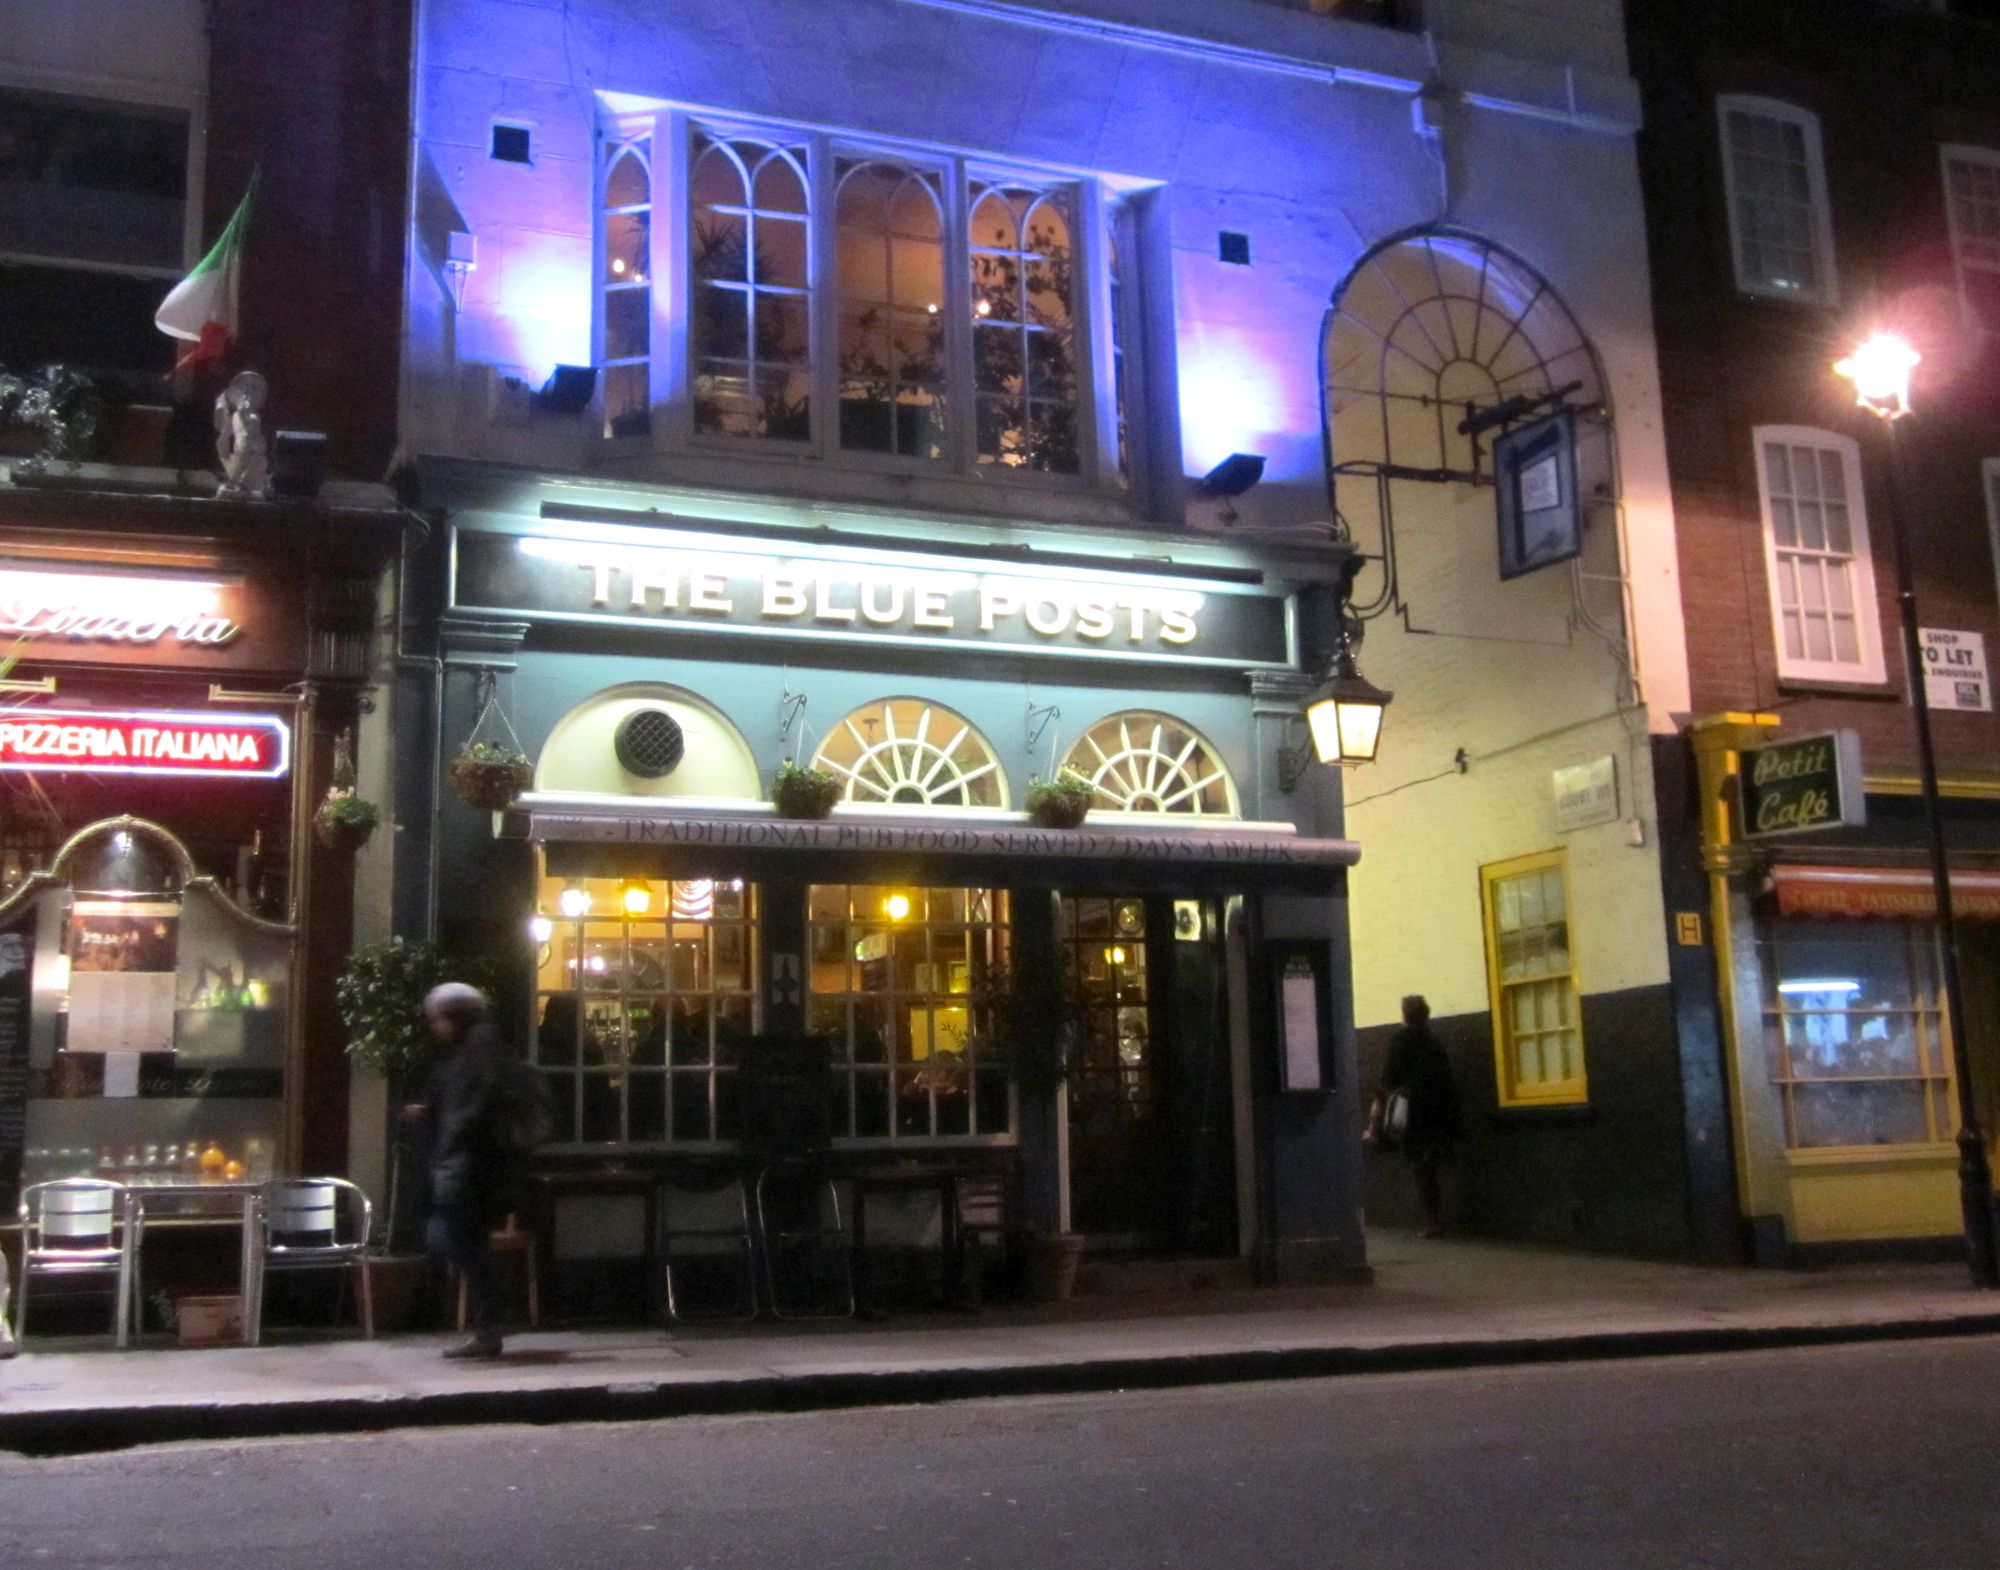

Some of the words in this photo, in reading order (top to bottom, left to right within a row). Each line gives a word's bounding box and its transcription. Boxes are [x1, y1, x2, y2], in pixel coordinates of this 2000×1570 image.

[577, 561, 733, 614] THE
[760, 572, 954, 629] BLUE
[978, 587, 1198, 645] POSTS
[1926, 631, 1959, 644] SHOP
[1945, 647, 1973, 666] LET
[0, 722, 127, 757] PIZZERIA
[131, 727, 260, 762] ITALIANA
[1753, 744, 1829, 787] Petit
[1757, 790, 1829, 830] Café
[618, 818, 822, 847] TRADITIONAL
[837, 825, 893, 848] PUB
[902, 828, 980, 851] FOOD
[991, 832, 1097, 855] SERVED
[1126, 836, 1194, 857] DAYS
[1204, 839, 1217, 859] A
[1223, 840, 1294, 863] WEEK
